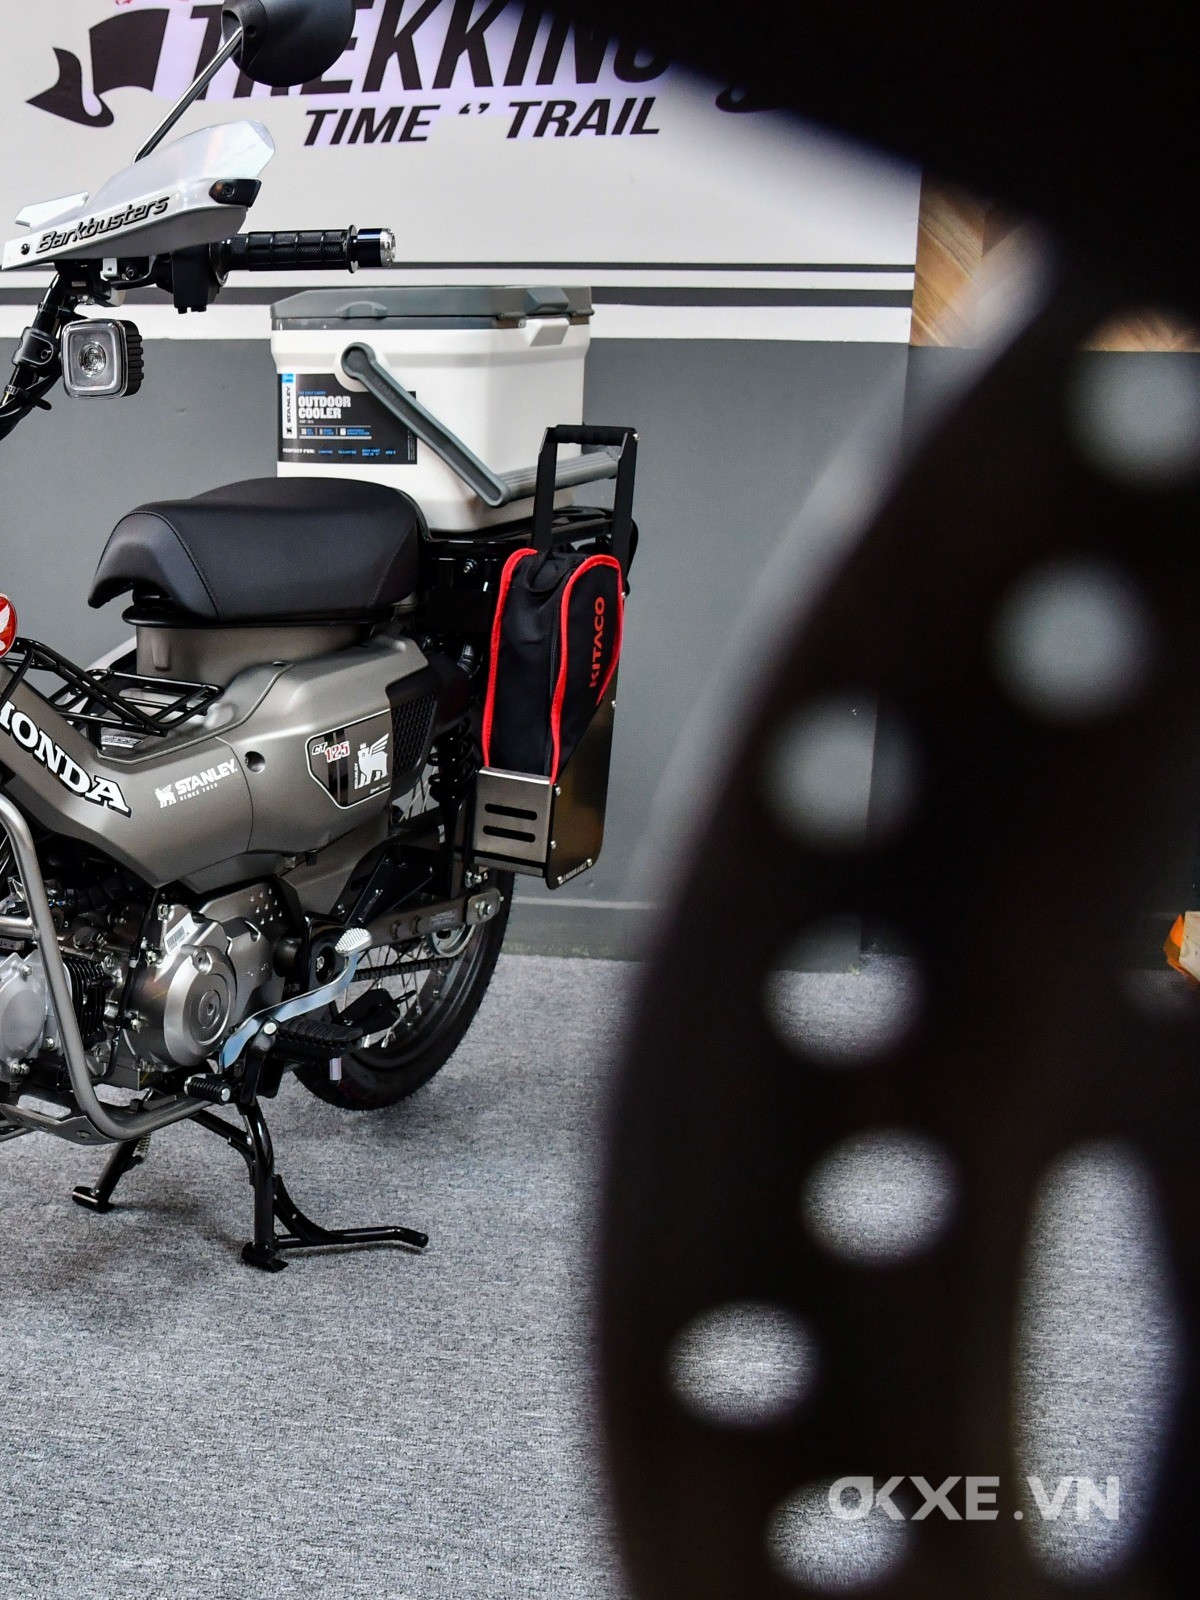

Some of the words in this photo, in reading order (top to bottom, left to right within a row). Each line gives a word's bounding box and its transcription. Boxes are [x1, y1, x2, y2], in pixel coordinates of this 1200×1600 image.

[304, 104, 441, 147] TIME
[506, 96, 661, 140] TRAIL
[35, 196, 170, 254] Barkbusters
[298, 395, 351, 408] OUTDOOR
[298, 407, 342, 419] COOLER
[589, 596, 605, 688] KITACO
[312, 741, 328, 755] CT
[325, 740, 350, 763] 125
[174, 758, 236, 796] STANLEY
